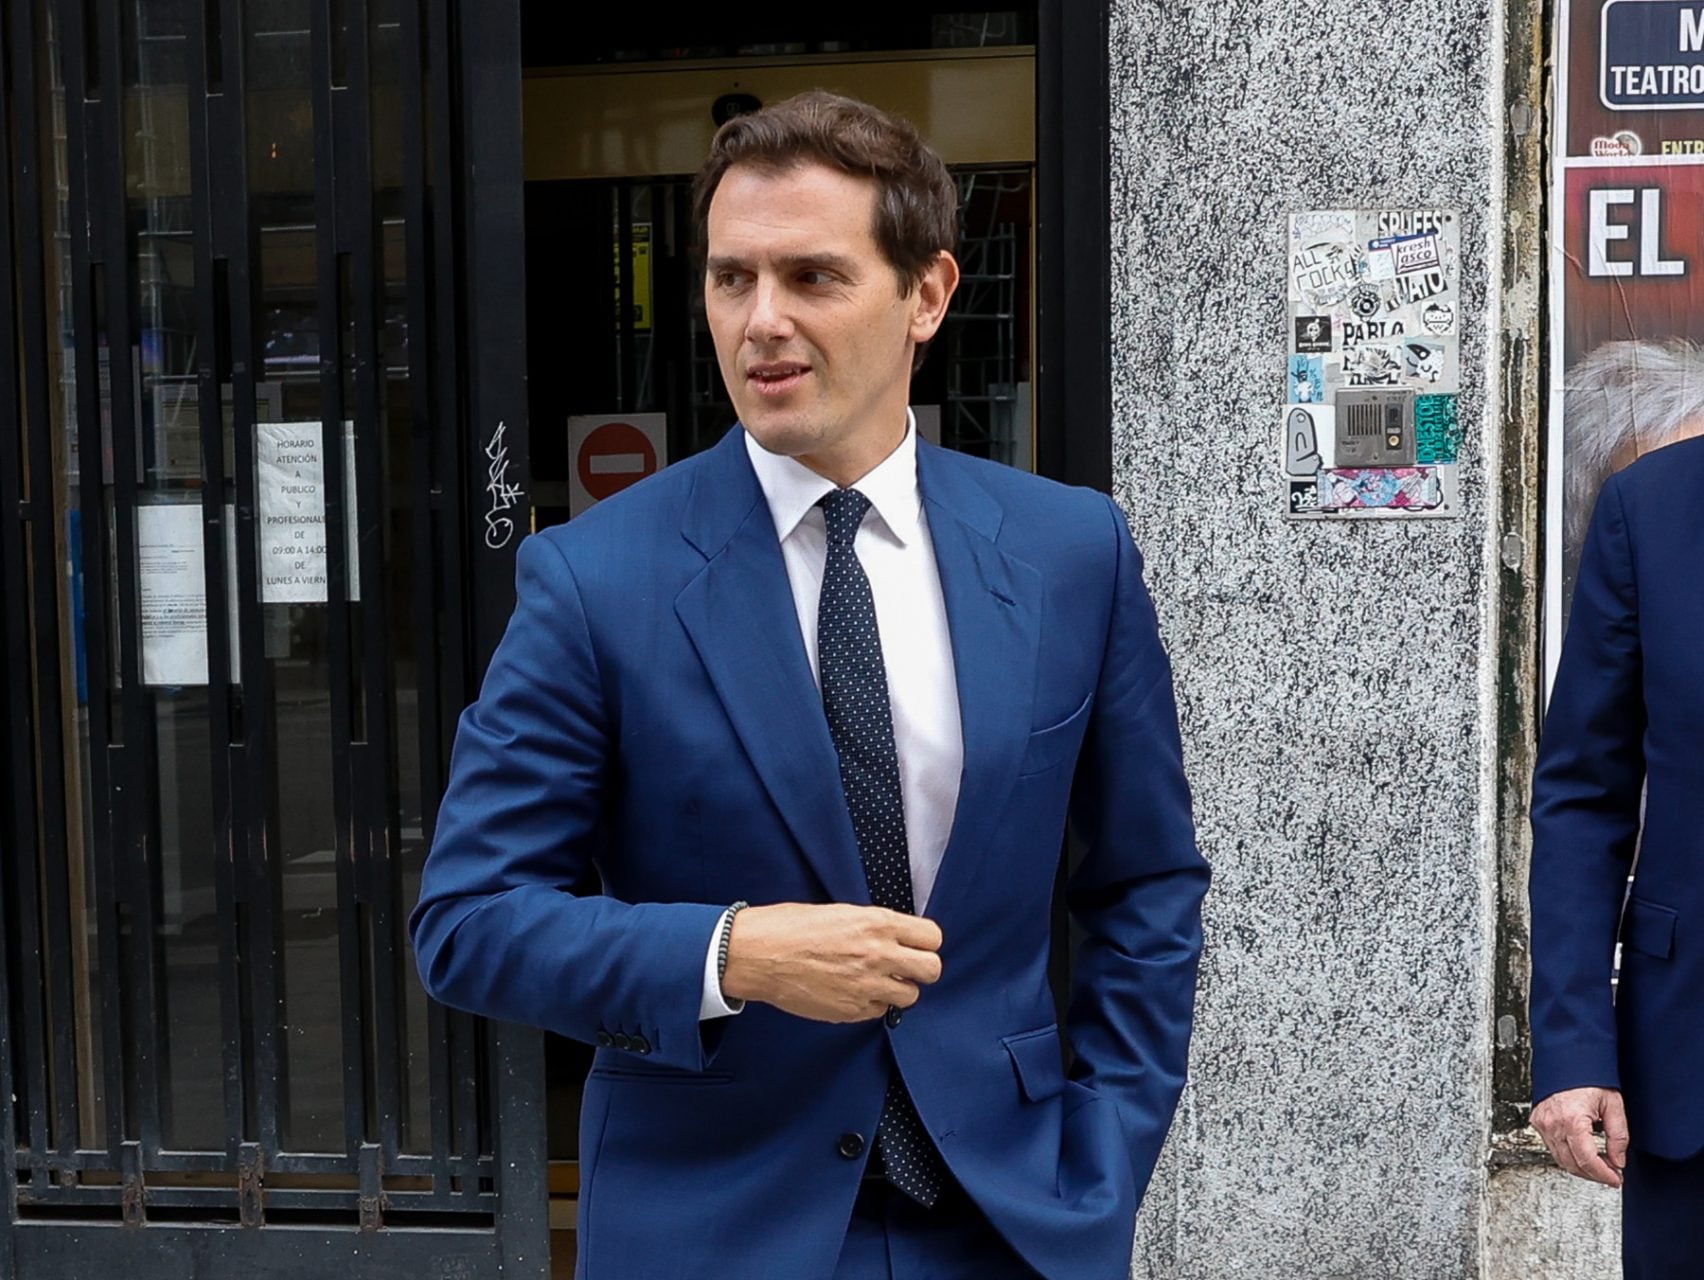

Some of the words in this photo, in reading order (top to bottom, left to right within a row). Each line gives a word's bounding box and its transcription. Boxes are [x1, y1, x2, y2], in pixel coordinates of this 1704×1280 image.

[1610, 65, 1704, 95] TEATRO
[1589, 188, 1685, 277] EL
[1293, 250, 1322, 273] ALL
[277, 440, 315, 448] HORARIO
[276, 454, 317, 464] ATENCIÓN
[295, 470, 301, 478] A
[294, 531, 305, 539] DE
[294, 561, 305, 570] DE
[266, 577, 292, 585] LUNES
